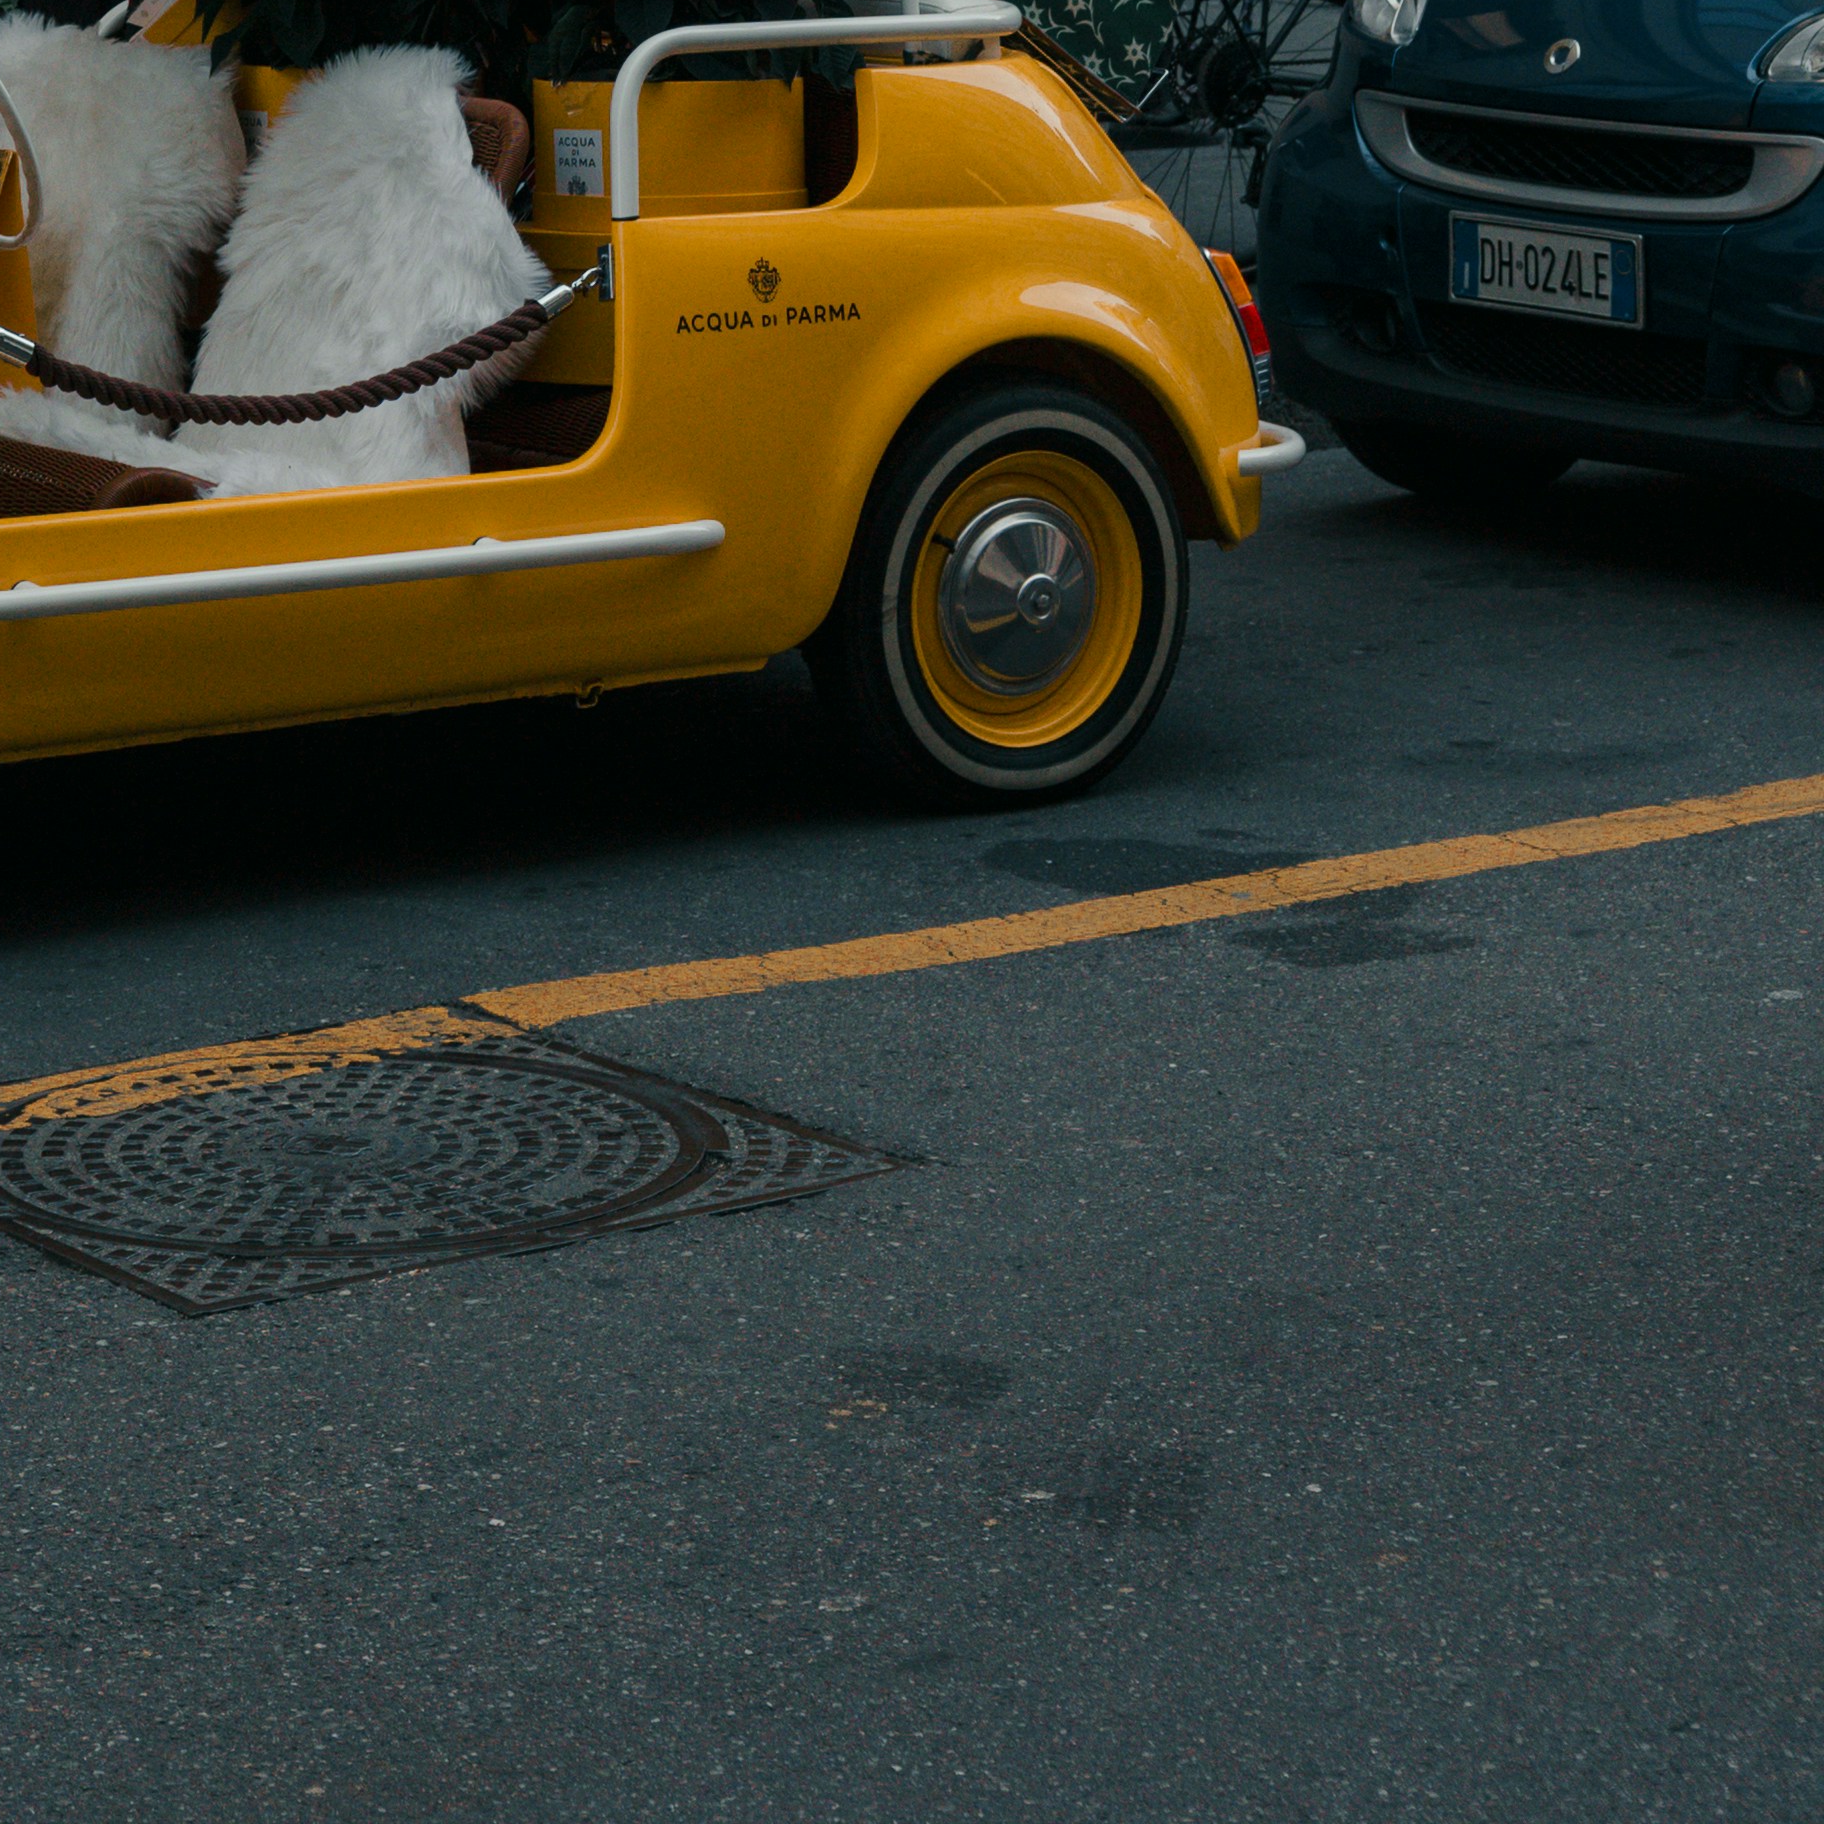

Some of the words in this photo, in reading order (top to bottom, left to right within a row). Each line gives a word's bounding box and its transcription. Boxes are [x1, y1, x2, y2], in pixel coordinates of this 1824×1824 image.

[558, 136, 595, 148] ACQUA
[559, 157, 596, 168] PARMA
[676, 310, 754, 334] ACQUA
[761, 314, 778, 328] DI
[785, 303, 861, 325] PARMA
